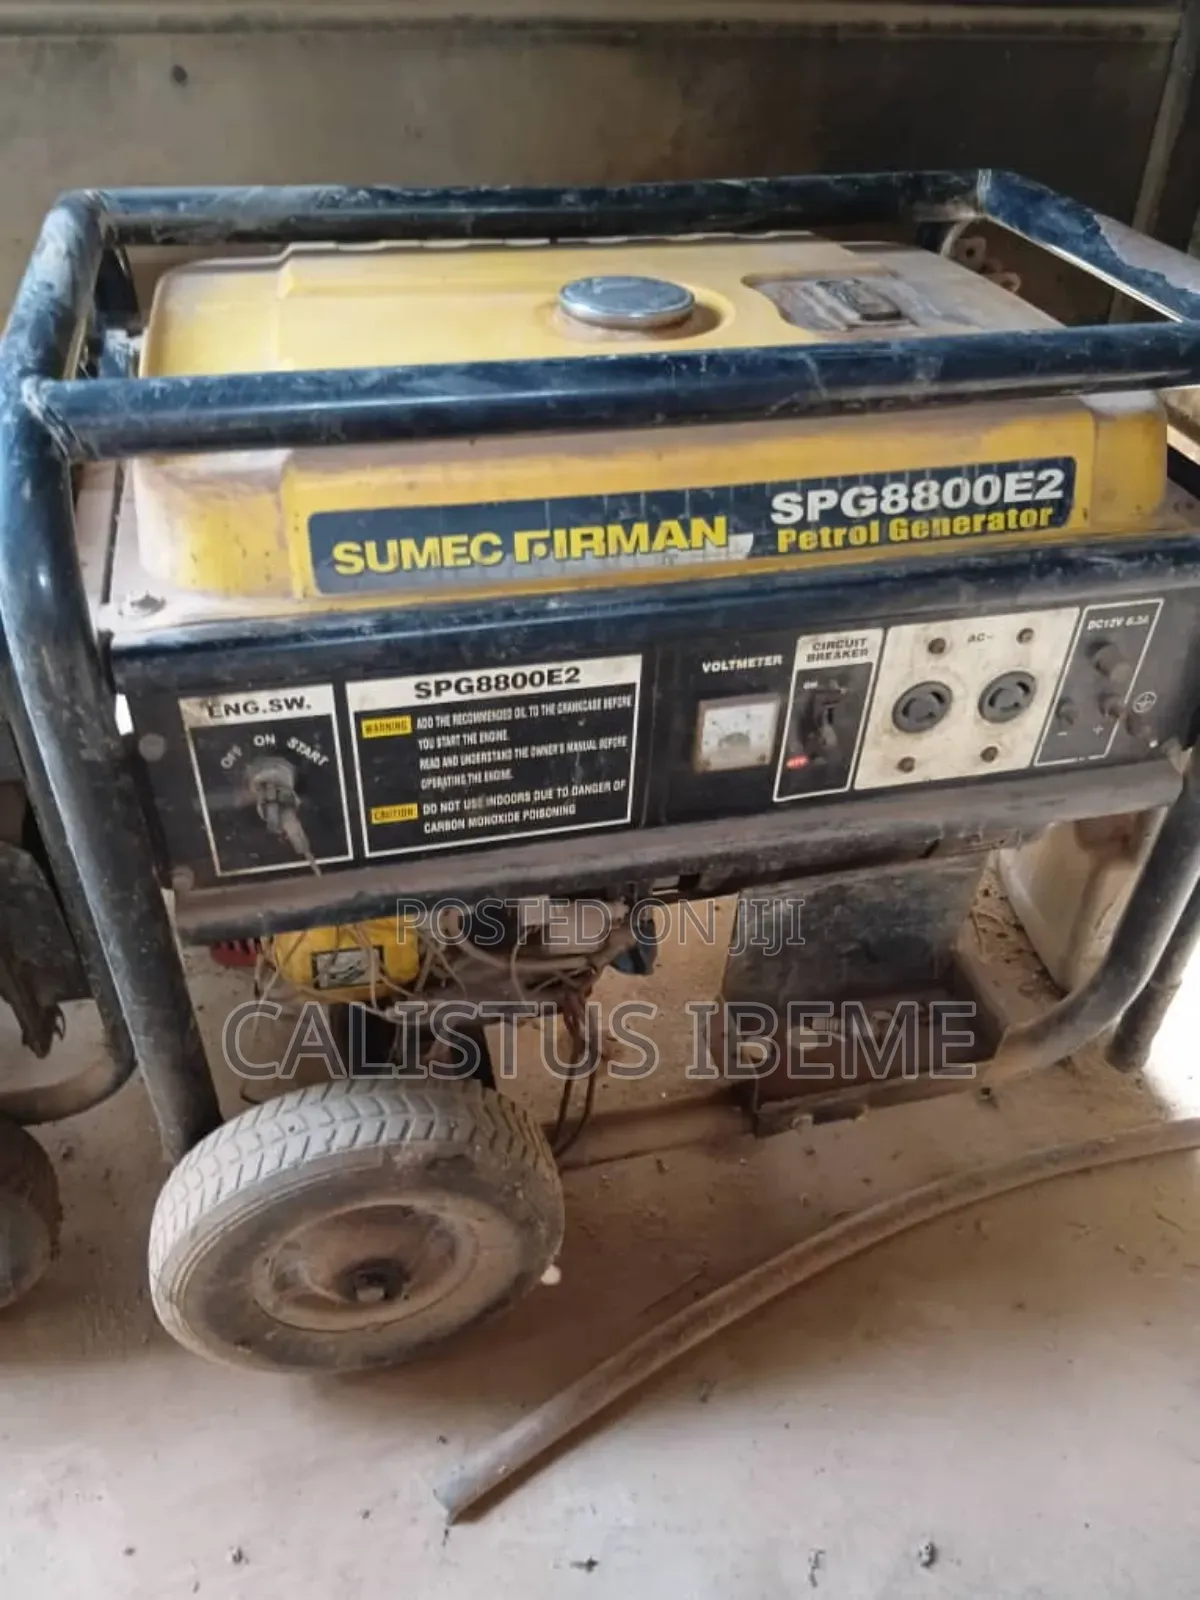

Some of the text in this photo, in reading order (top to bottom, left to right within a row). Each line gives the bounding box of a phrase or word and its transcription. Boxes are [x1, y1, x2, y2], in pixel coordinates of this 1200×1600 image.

[770, 468, 1064, 525] SPG8800E2
[777, 507, 1053, 553] Petrol Generator
[333, 516, 728, 576] SUMEC FIRMAN
[806, 648, 869, 663] BREAKER
[812, 638, 867, 651] CIRCUIT
[702, 654, 783, 673] VOLTMETER
[414, 666, 581, 699] SPG8800E2
[364, 719, 409, 734] WARNING
[417, 694, 632, 729] ADD THE RECOMMENDED OIL TO THE CRANKCASE BEFORE
[253, 733, 276, 747] ON
[286, 736, 329, 767] START
[418, 736, 435, 750] YOU
[436, 734, 461, 748] START
[462, 732, 478, 746] THE
[419, 756, 441, 771] READ
[442, 753, 459, 768] AND
[460, 747, 512, 766] UNDERSTAND
[514, 746, 529, 759] THE
[566, 739, 598, 754] MANUAL
[599, 735, 628, 751] BEFORE
[421, 774, 466, 791] OPERATING
[467, 771, 482, 785] THE
[423, 778, 627, 815] DO NOT USE INDOORS DUE TO DANGER OF
[373, 806, 414, 821] CAUTION
[424, 803, 577, 834] CARBON MONOXIDE POISONING
